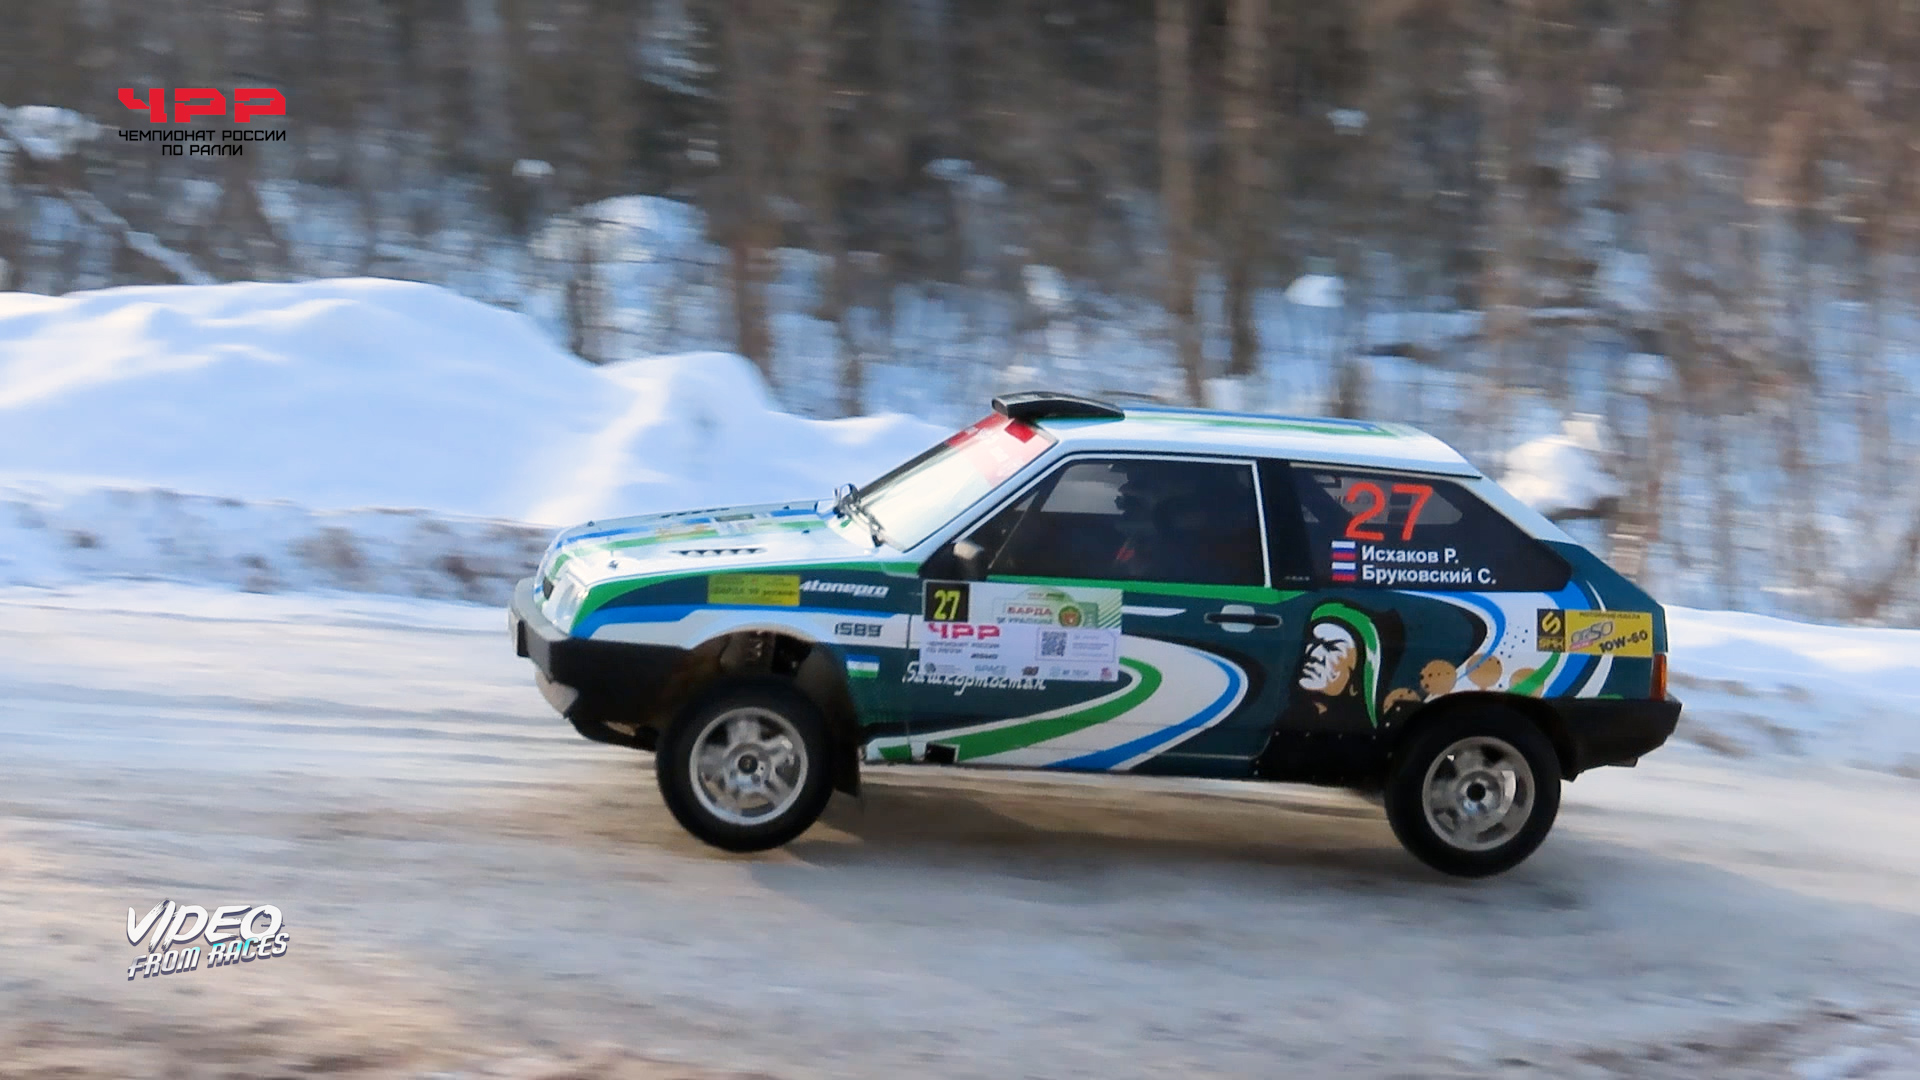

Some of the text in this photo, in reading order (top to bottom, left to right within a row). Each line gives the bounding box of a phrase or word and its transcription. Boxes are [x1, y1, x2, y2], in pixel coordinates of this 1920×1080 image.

[1344, 482, 1433, 542] 27
[1361, 545, 1460, 564] Исхаков Р.
[1361, 564, 1497, 586] Бруковский С.
[933, 589, 961, 621] 27
[927, 622, 1000, 640] ЧРР
